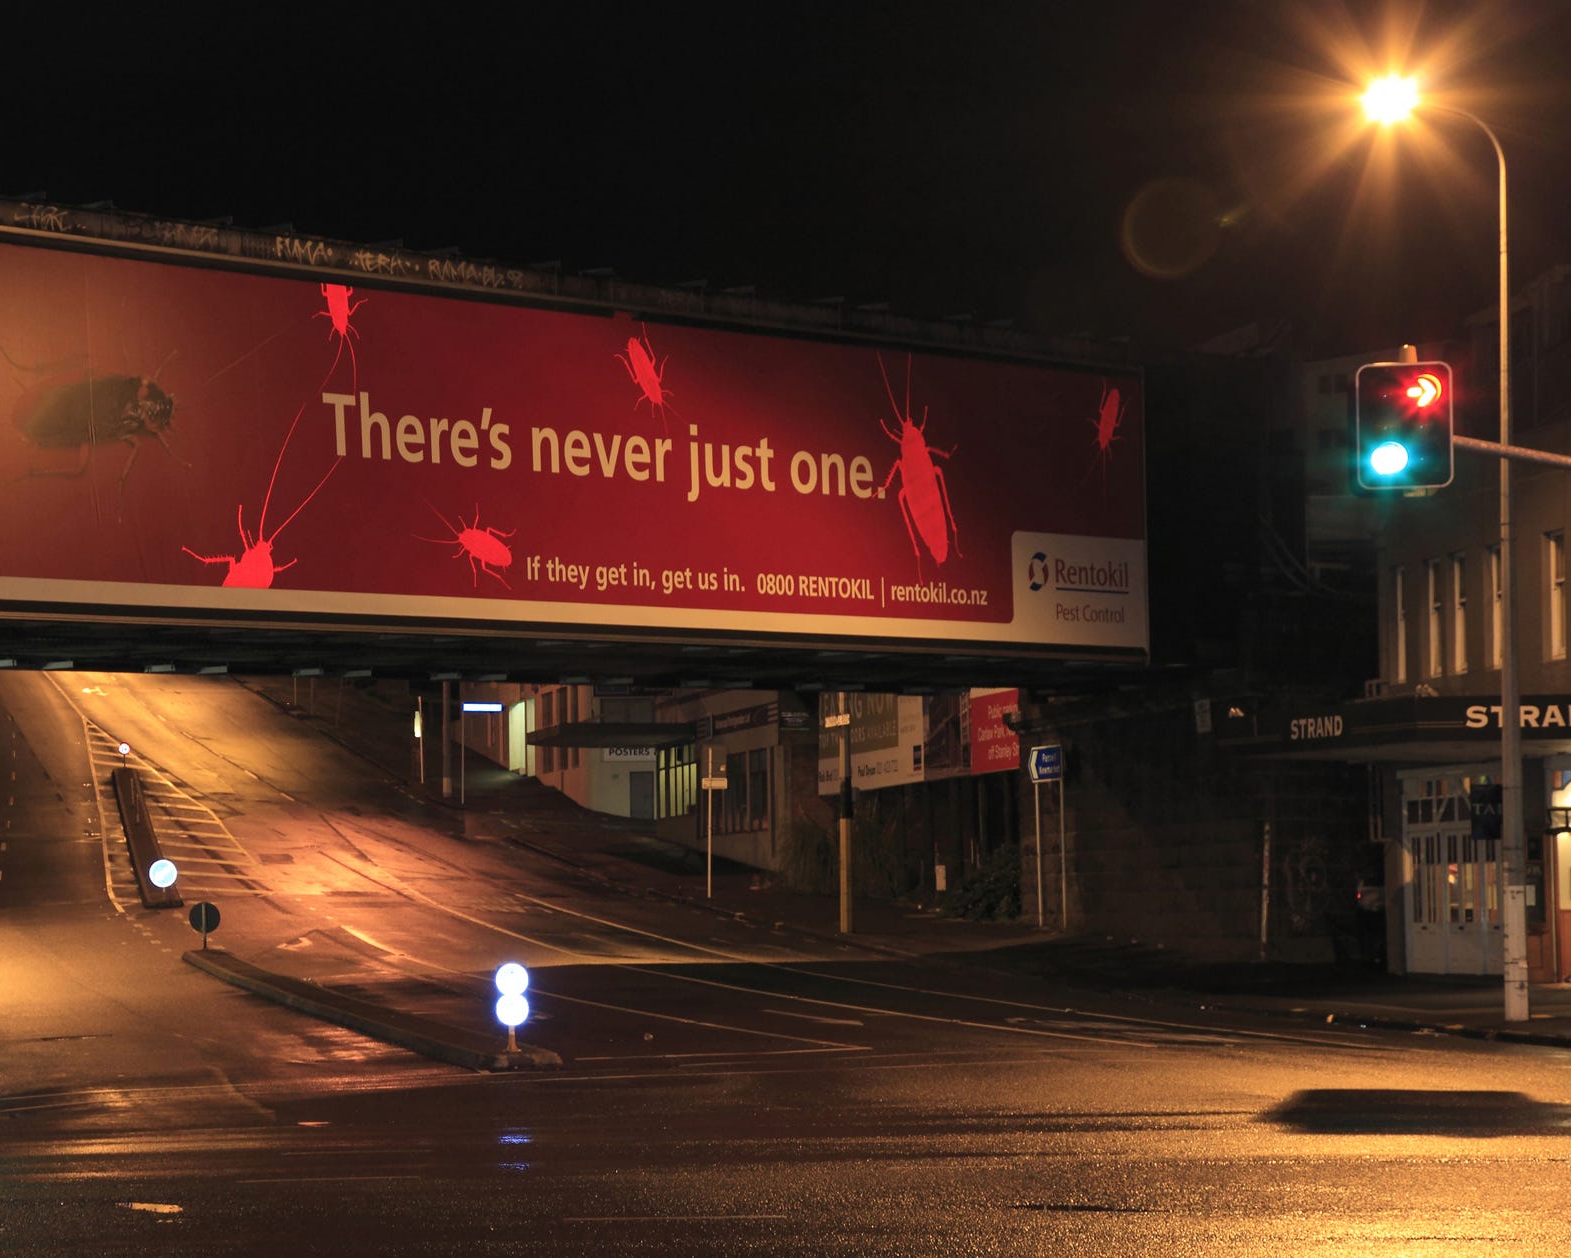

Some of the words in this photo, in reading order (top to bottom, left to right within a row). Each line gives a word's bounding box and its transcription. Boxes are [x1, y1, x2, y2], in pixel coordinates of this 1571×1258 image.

[322, 391, 512, 470] There's
[531, 426, 672, 482] never
[687, 424, 776, 502] just
[789, 450, 886, 500] one.
[526, 555, 540, 581] If
[546, 556, 590, 590] they
[595, 563, 627, 591] get
[633, 562, 656, 590] in,
[661, 567, 693, 594] get
[698, 571, 718, 590] us
[723, 567, 746, 592] in.
[757, 573, 794, 596] 0800
[799, 576, 874, 600] RENTOKIL
[1055, 558, 1129, 589] Rentokil
[891, 581, 988, 606] rentokil.co.nz
[1056, 604, 1080, 622] Pest
[1082, 605, 1125, 624] Control
[1290, 715, 1343, 740] STRAND
[609, 748, 650, 757] POSTERS
[1472, 803, 1501, 815] TA
